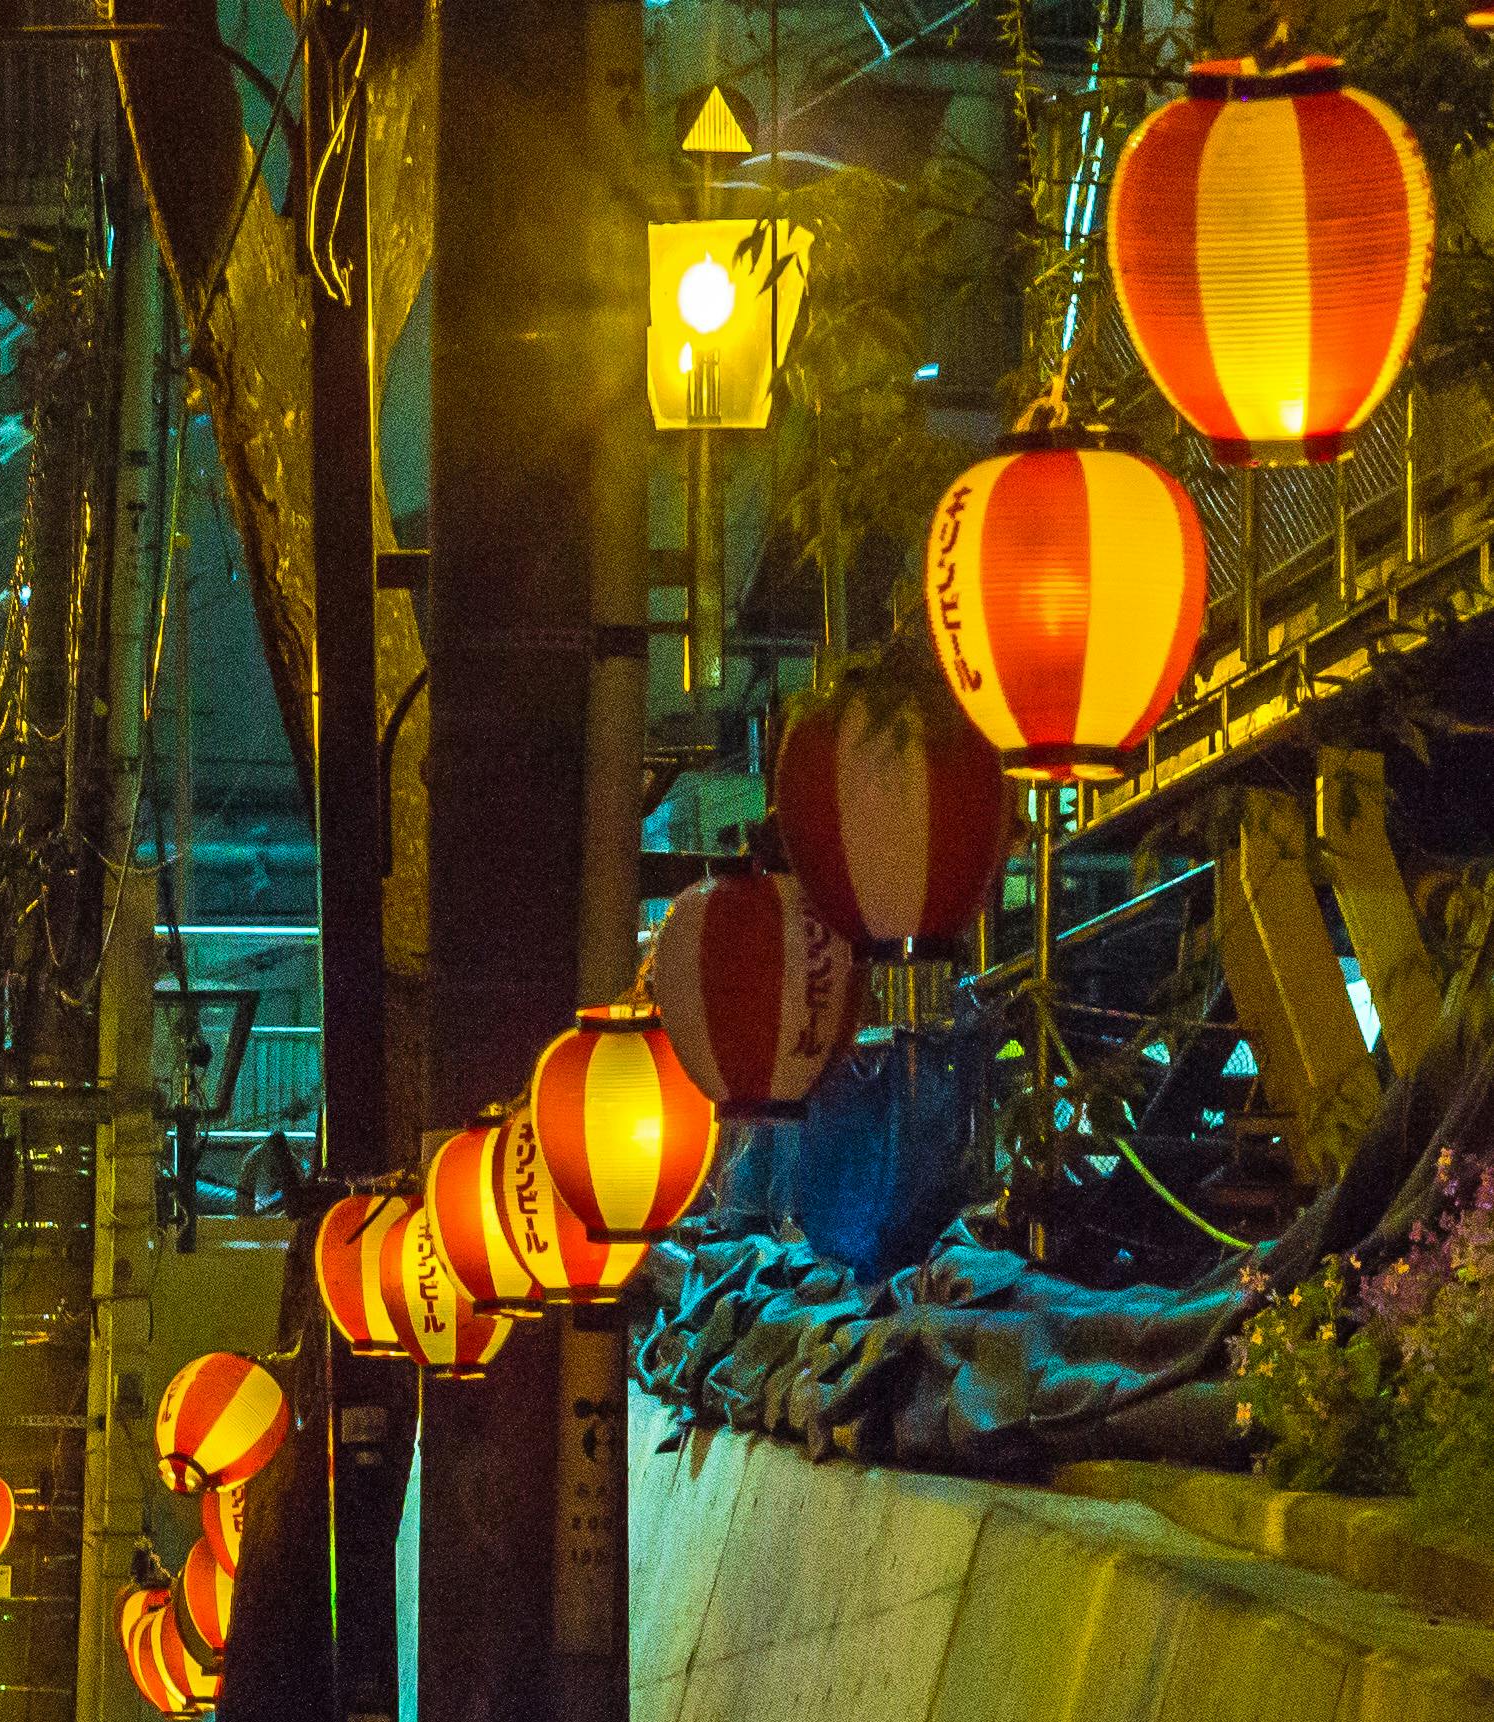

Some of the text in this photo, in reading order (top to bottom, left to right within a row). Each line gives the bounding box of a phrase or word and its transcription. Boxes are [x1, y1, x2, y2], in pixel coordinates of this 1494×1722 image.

[514, 1122, 549, 1255] キリンビール
